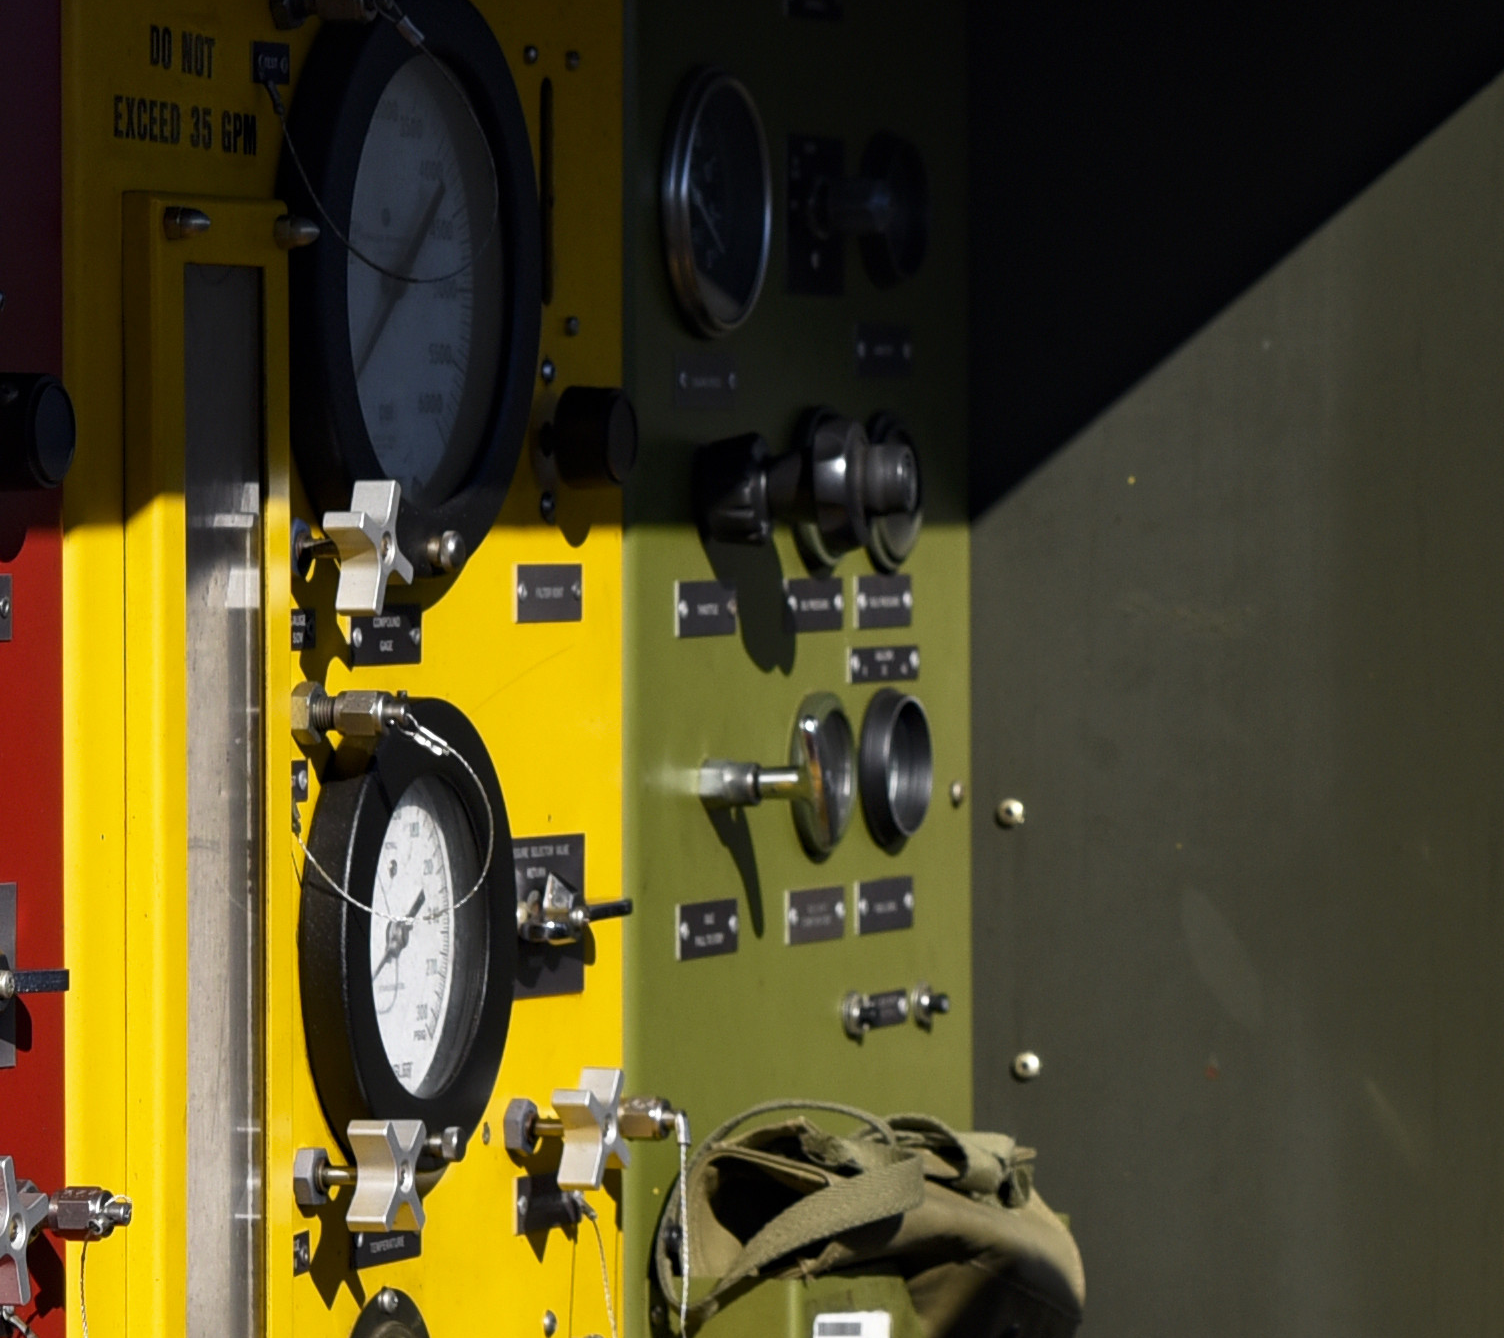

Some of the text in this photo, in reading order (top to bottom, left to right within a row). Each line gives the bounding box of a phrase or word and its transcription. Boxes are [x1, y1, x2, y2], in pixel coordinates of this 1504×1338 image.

[151, 24, 216, 80] DO NOT
[113, 94, 257, 156] EXCEED 35 GPM
[373, 615, 401, 629] COMPOUND
